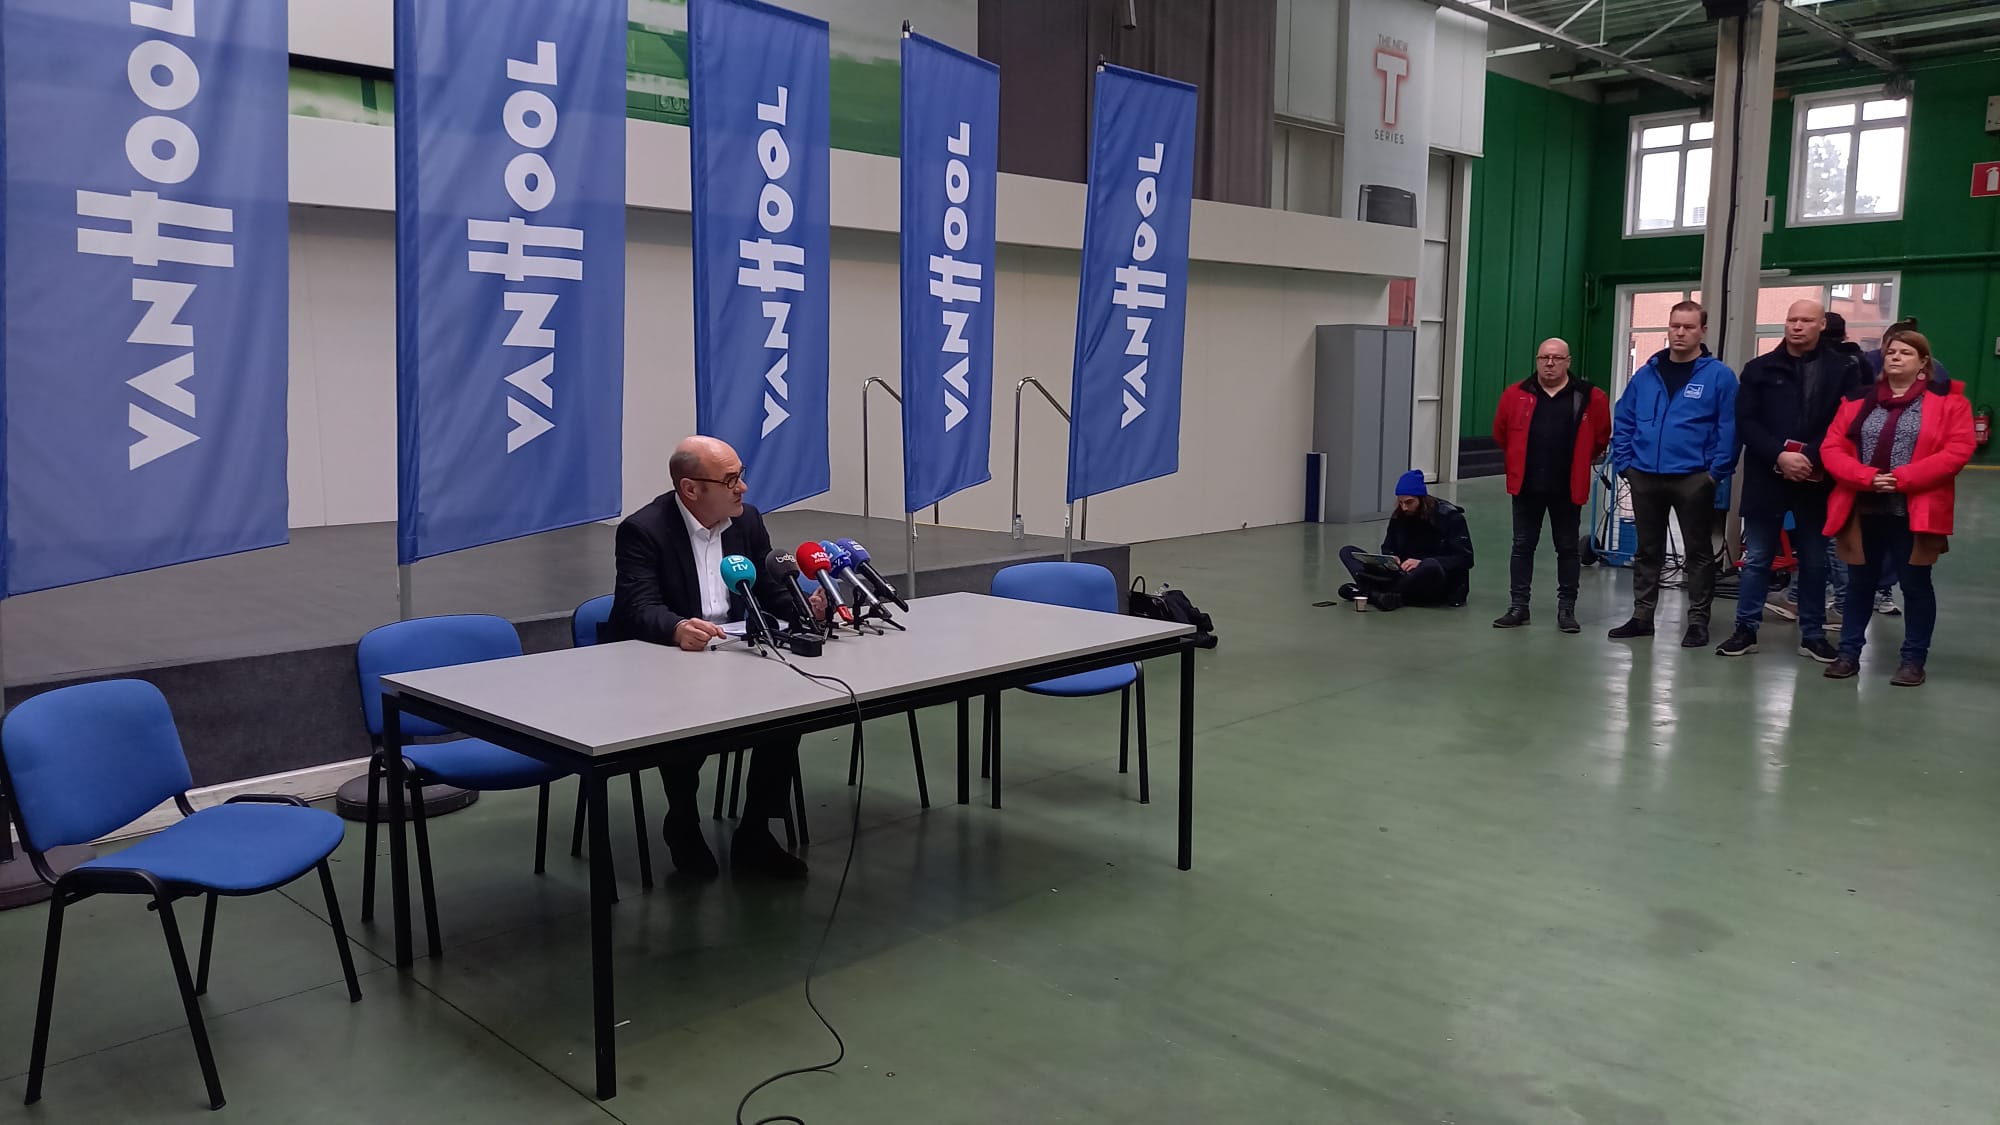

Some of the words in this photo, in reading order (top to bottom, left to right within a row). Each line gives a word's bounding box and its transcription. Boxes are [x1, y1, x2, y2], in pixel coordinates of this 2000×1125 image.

[1378, 34, 1392, 49] THE
[1392, 38, 1409, 54] NEW
[1374, 49, 1410, 127] T
[1374, 128, 1405, 145] SERIES
[775, 552, 797, 563] belg
[732, 563, 748, 572] rtv
